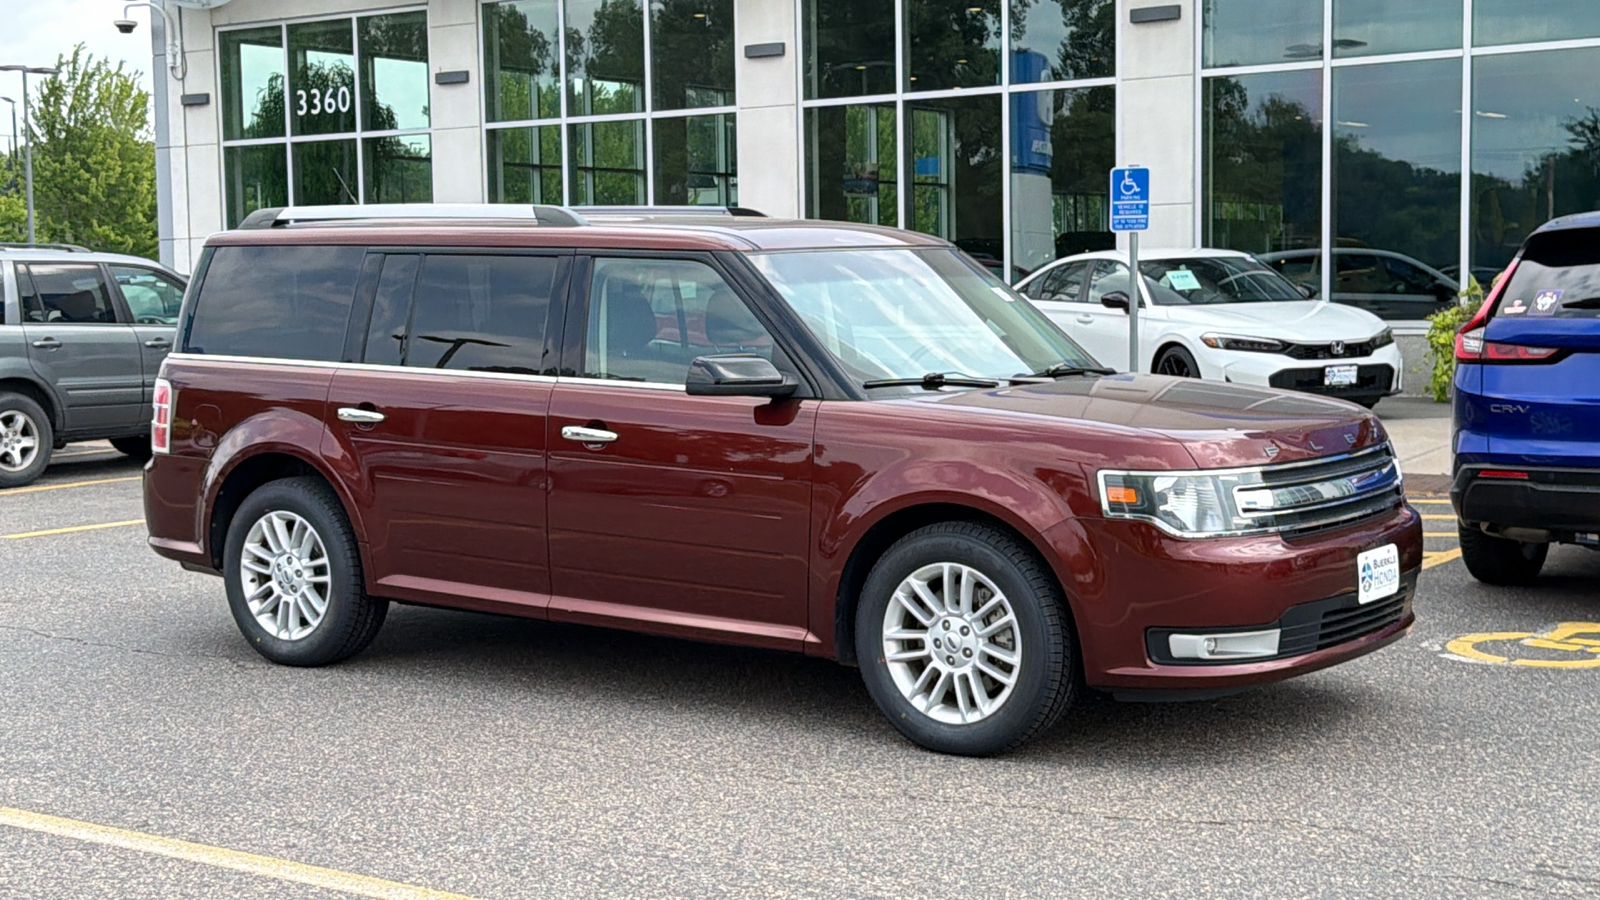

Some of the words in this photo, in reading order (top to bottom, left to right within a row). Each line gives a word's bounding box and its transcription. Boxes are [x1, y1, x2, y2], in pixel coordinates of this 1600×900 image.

[297, 86, 350, 116] 3360
[1490, 404, 1530, 414] CR-V
[1374, 568, 1397, 586] HONDA
